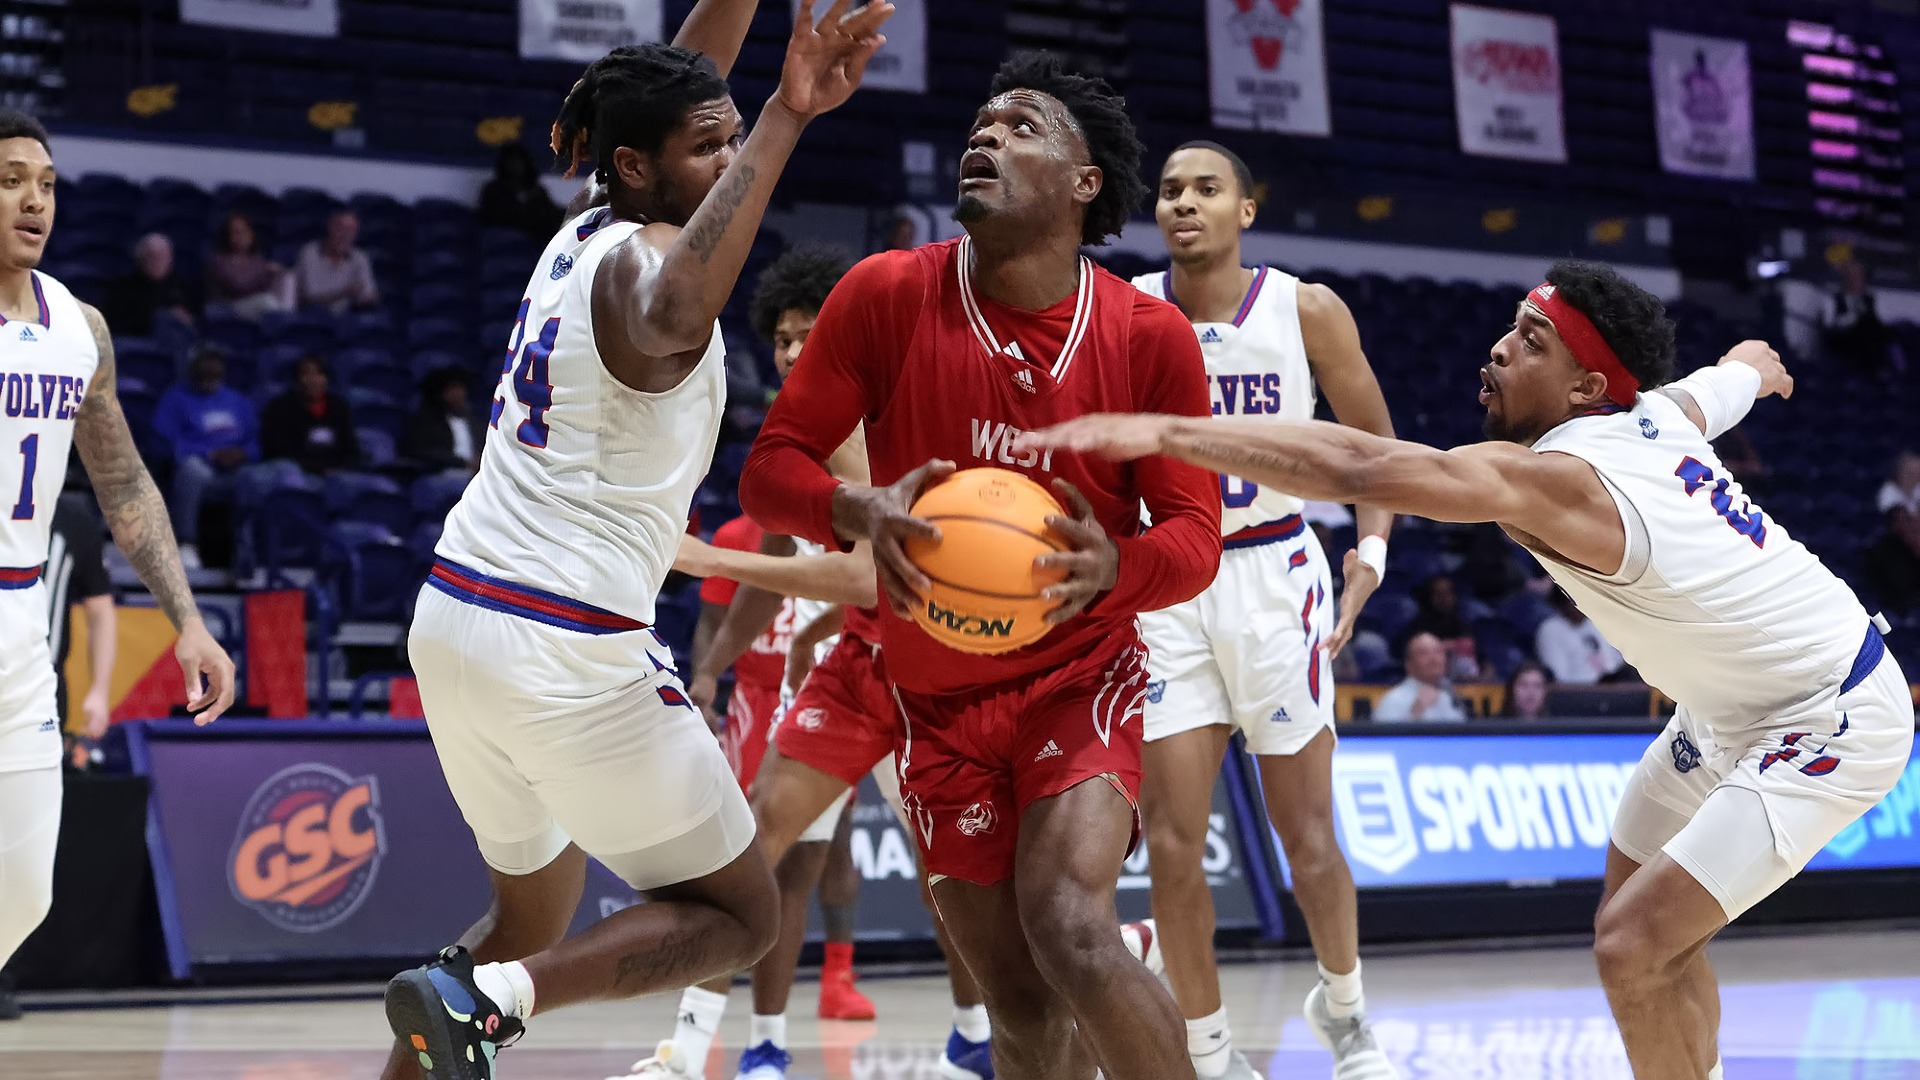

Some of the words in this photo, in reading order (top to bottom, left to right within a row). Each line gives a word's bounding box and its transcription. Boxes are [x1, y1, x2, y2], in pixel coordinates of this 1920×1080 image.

[0, 372, 84, 421] OLVES
[11, 433, 39, 520] 1
[927, 599, 1016, 637] NCAA
[235, 783, 376, 900] GSC
[1409, 762, 1637, 853] SPORTUR
